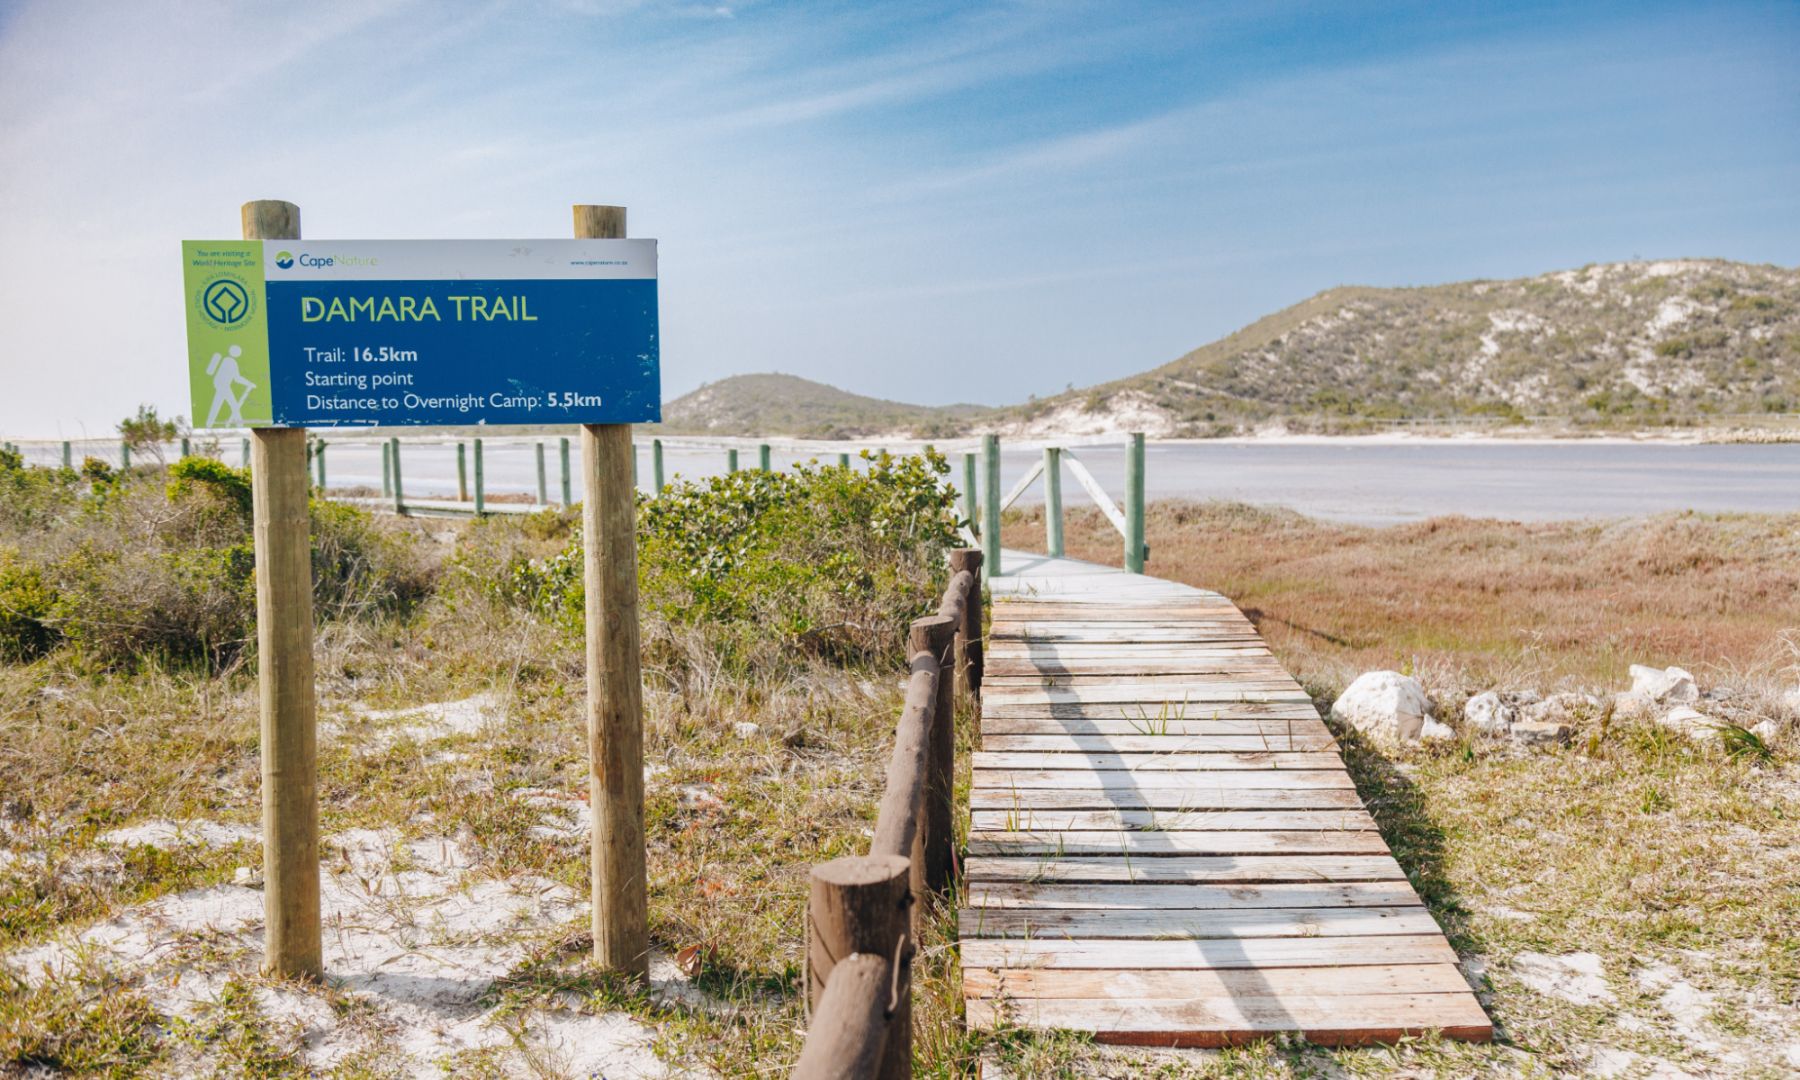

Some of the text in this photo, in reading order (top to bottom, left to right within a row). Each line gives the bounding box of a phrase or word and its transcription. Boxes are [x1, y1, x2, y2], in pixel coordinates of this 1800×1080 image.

[301, 295, 538, 323] DAMARA TRAIL
[303, 347, 418, 363] Trail: 16.5km
[304, 370, 414, 390] Starting point
[306, 392, 602, 413] Distance to Overnight Camp: 5.5km
